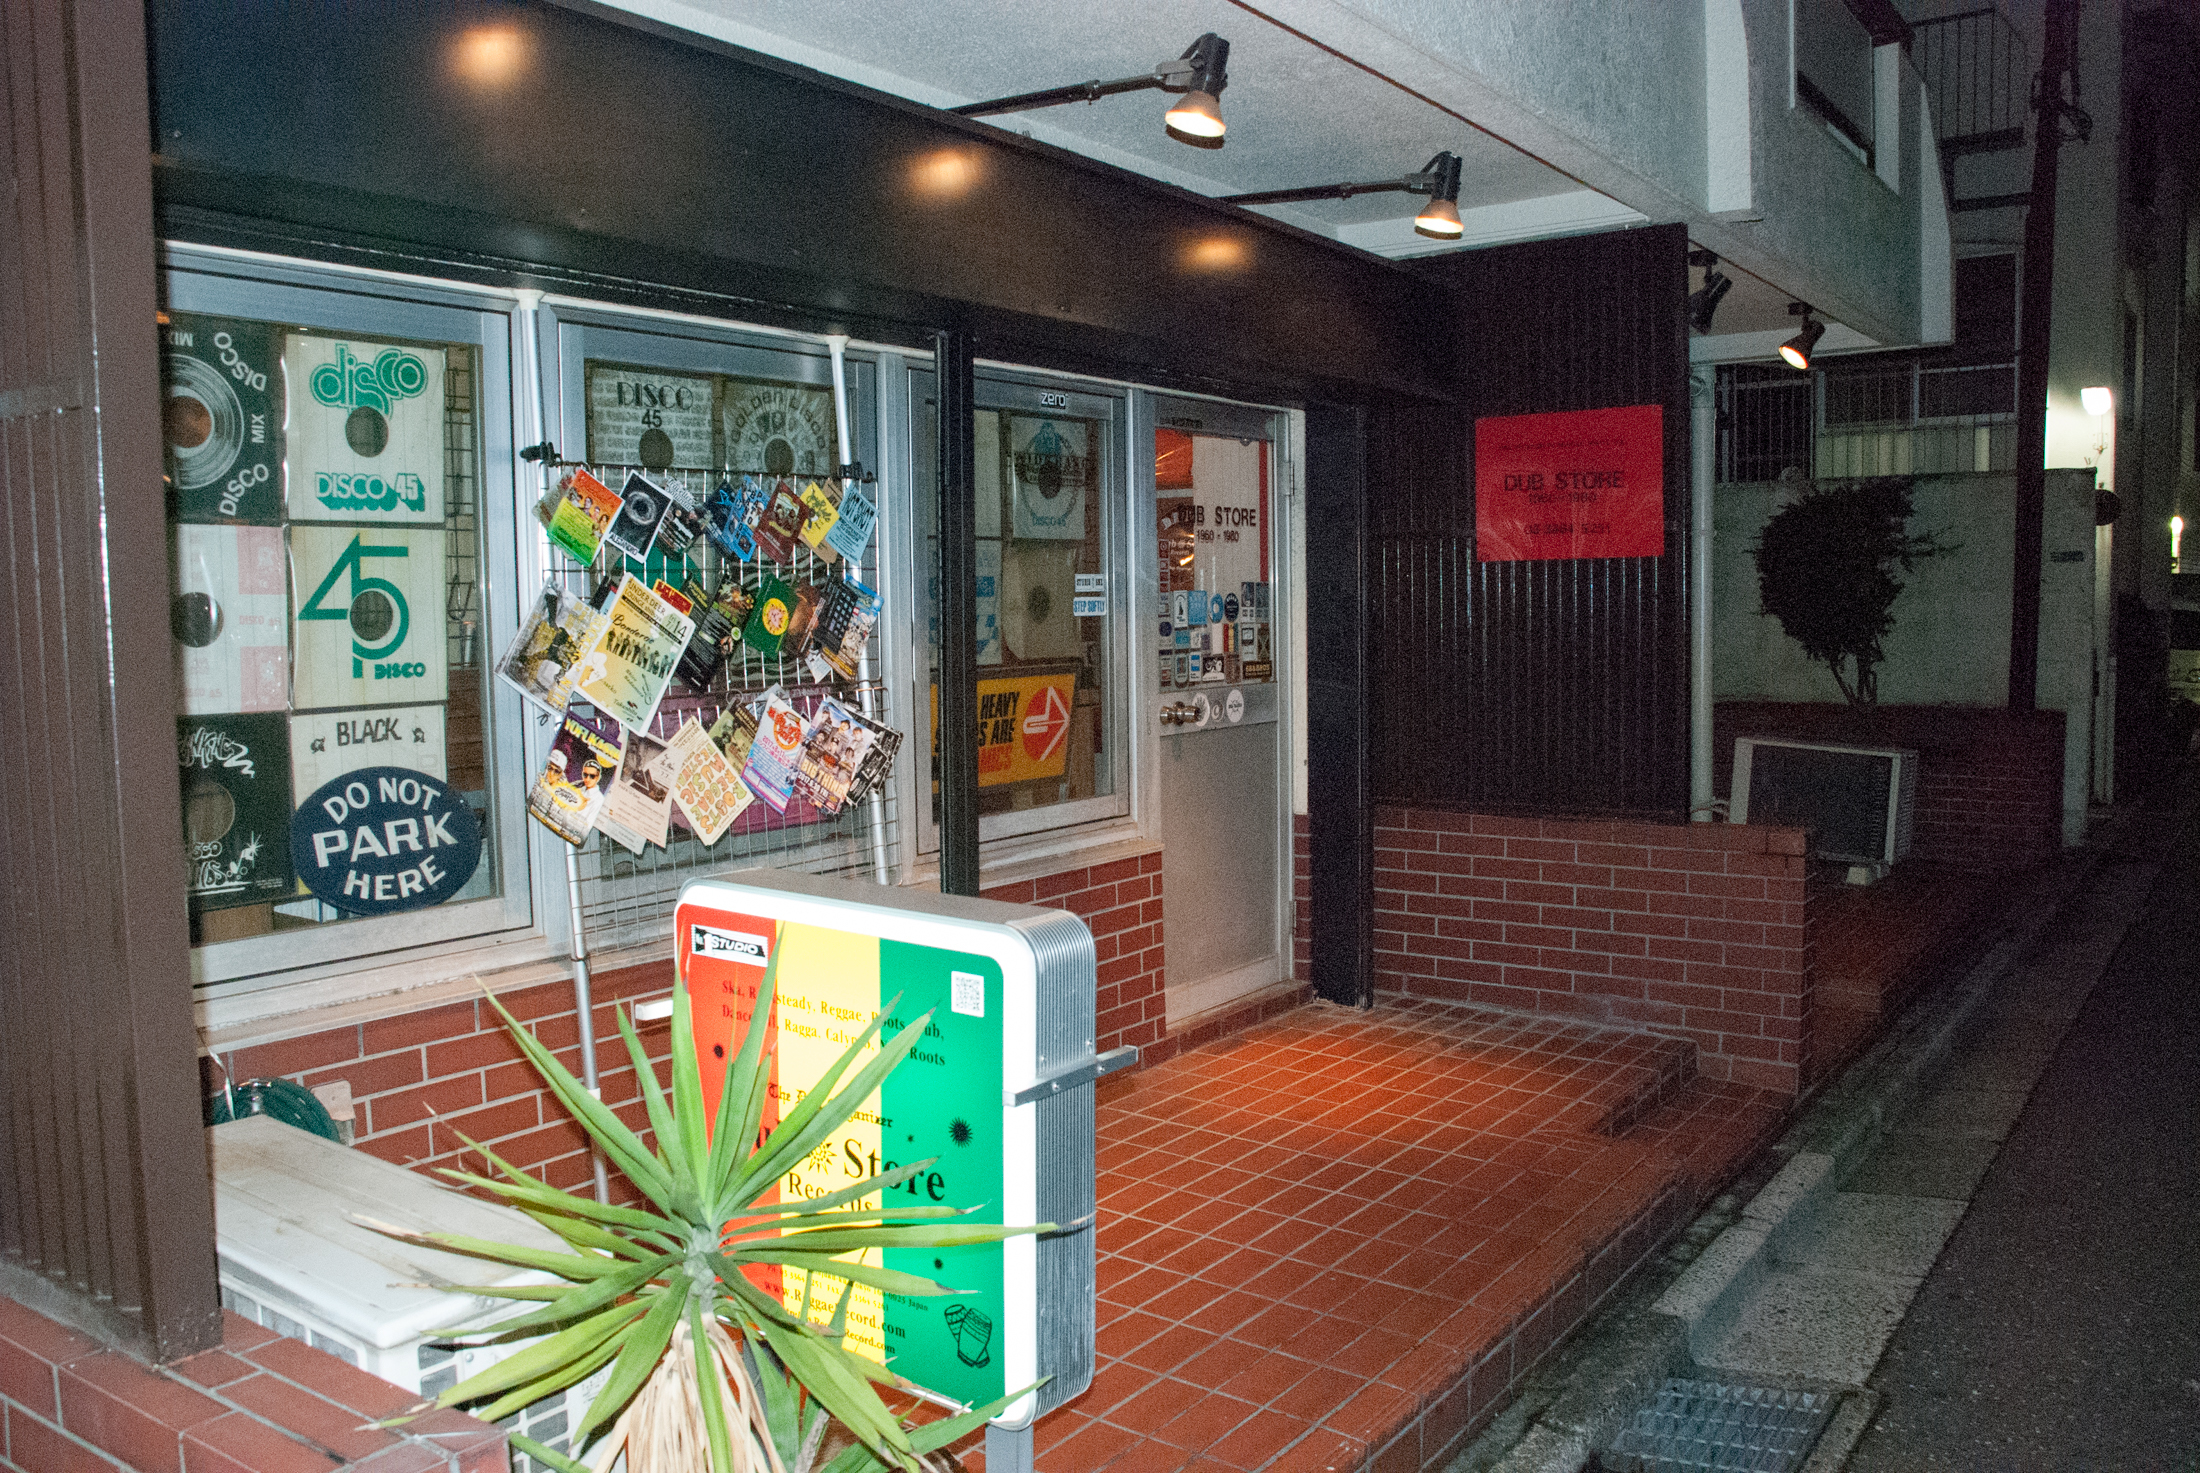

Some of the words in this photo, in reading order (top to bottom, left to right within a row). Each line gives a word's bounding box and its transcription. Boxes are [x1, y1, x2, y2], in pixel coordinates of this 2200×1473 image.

[214, 332, 267, 391] DISCO
[617, 381, 693, 410] DISCO
[251, 413, 265, 444] MIX
[641, 409, 662, 428] 45
[219, 463, 270, 517] DISCO
[315, 472, 392, 506] DISCO
[396, 473, 424, 508] 45
[1504, 473, 1543, 491] DUB
[1555, 471, 1625, 490] STORE
[1215, 506, 1256, 526] STORE
[1073, 600, 1087, 612] STEP
[374, 663, 426, 679] DISCO
[981, 692, 1020, 720] HEAVY
[336, 718, 401, 747] BLACK
[801, 758, 819, 779] BIG
[323, 782, 370, 824] DO
[379, 777, 440, 810] NOT
[690, 768, 736, 821] REGGAE
[313, 811, 459, 868] PARK
[343, 855, 446, 901] HERE
[821, 1001, 866, 1023] Reggae,
[924, 1023, 944, 1040] ub,
[785, 1019, 821, 1039] Ragga,
[910, 1046, 945, 1067] Roots
[908, 1298, 929, 1312] Japan
